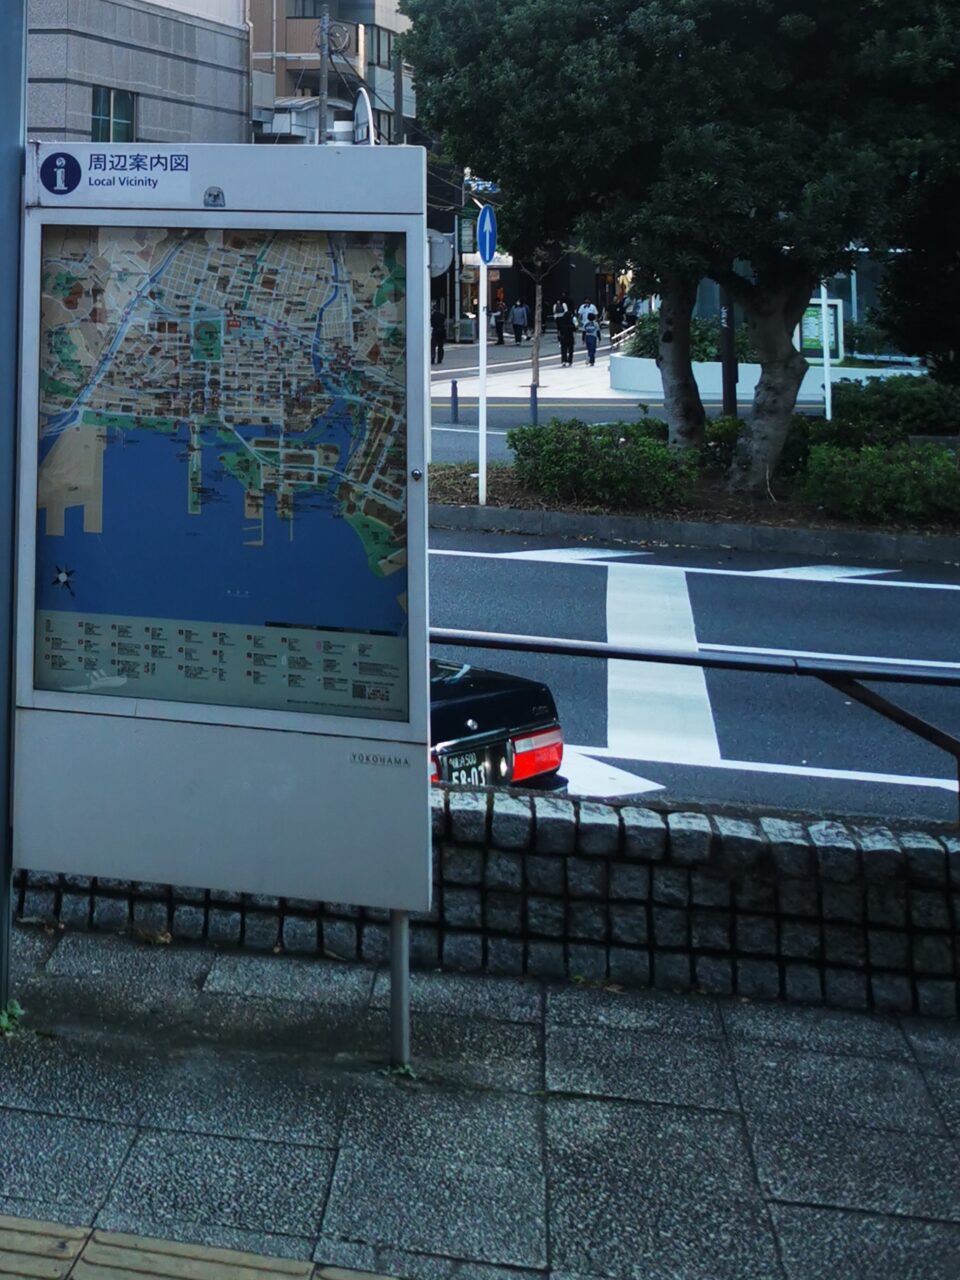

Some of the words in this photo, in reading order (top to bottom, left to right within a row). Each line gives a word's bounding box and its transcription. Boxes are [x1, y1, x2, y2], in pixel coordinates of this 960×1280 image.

[88, 153, 190, 172] 周辺案内図
[88, 176, 116, 187] Local
[118, 175, 159, 189] Vicinity
[351, 751, 411, 769] YOKOHAMA
